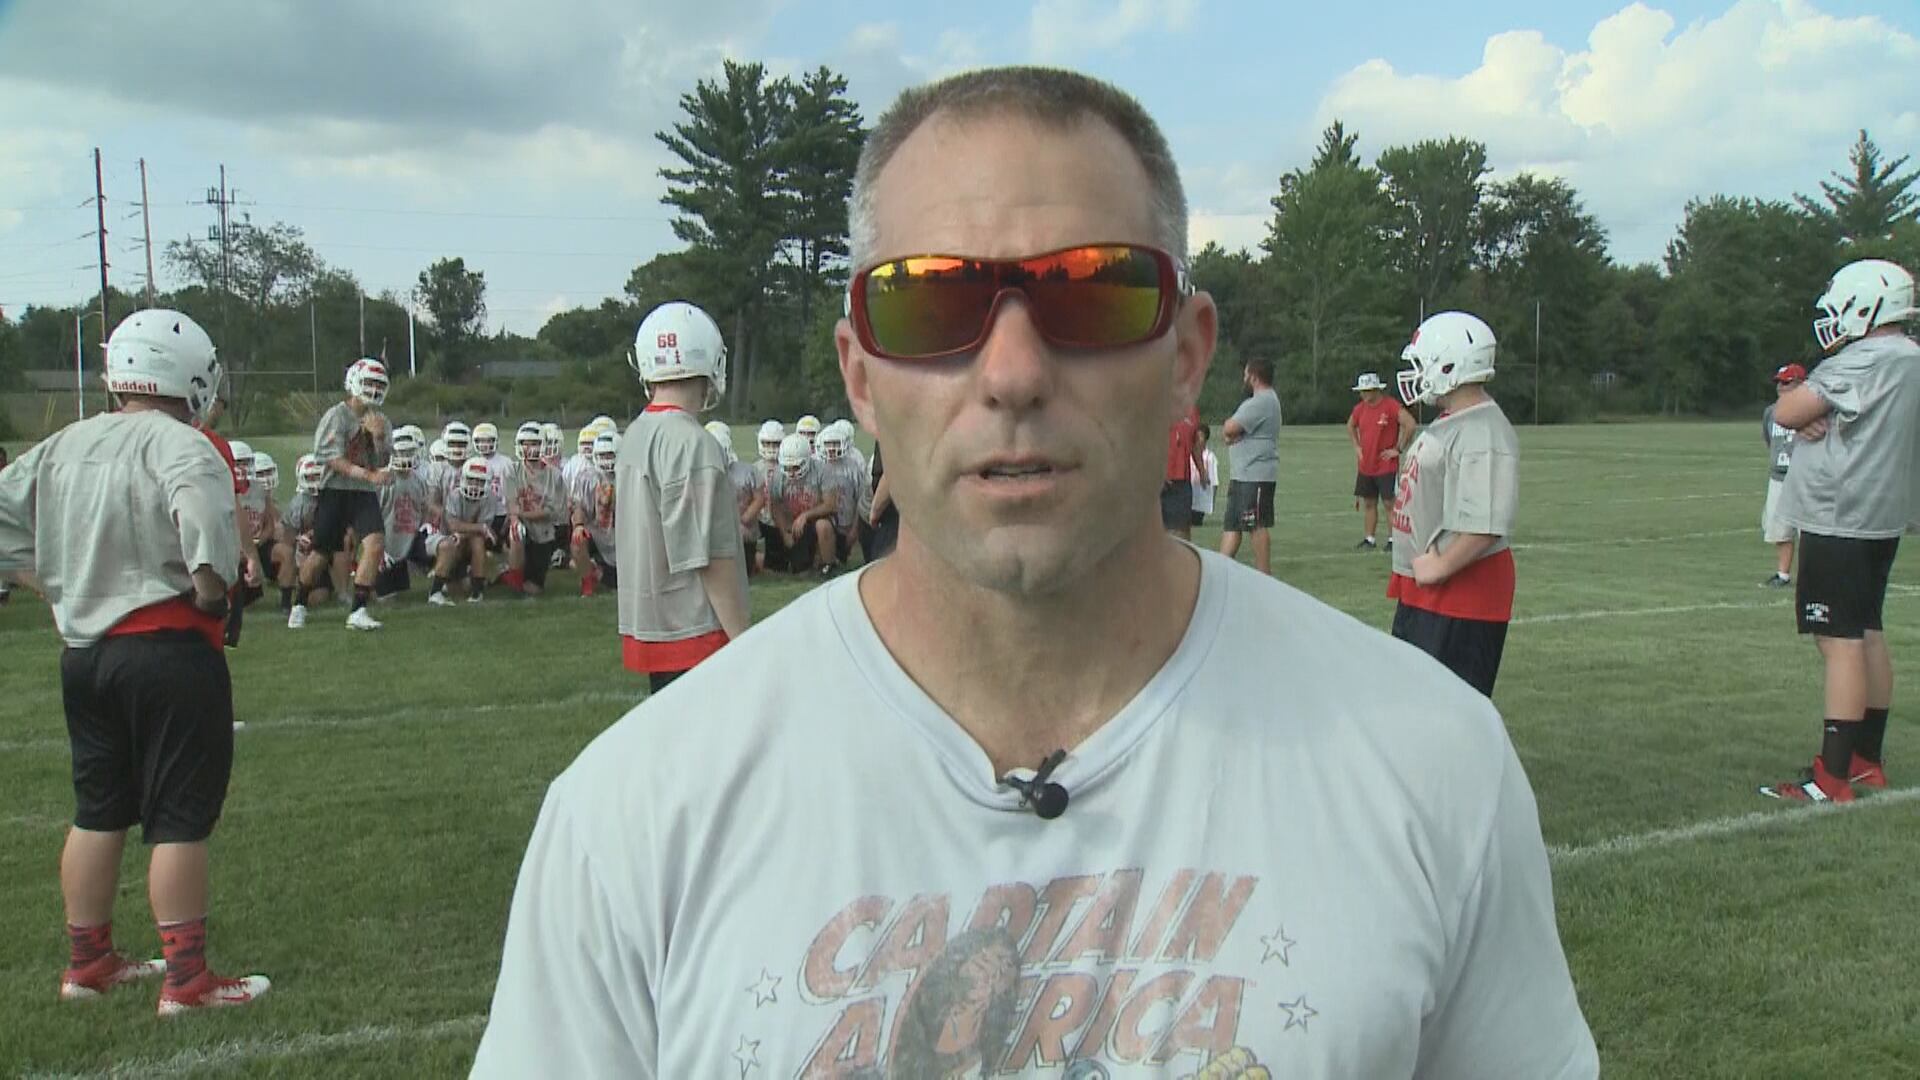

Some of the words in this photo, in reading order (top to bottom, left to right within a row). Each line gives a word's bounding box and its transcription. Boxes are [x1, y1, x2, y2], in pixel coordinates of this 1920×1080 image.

[657, 333, 677, 348] 68
[111, 380, 158, 393] Riddell
[797, 867, 1260, 1006] CAPTAIN
[791, 968, 1246, 1080] ARICA
